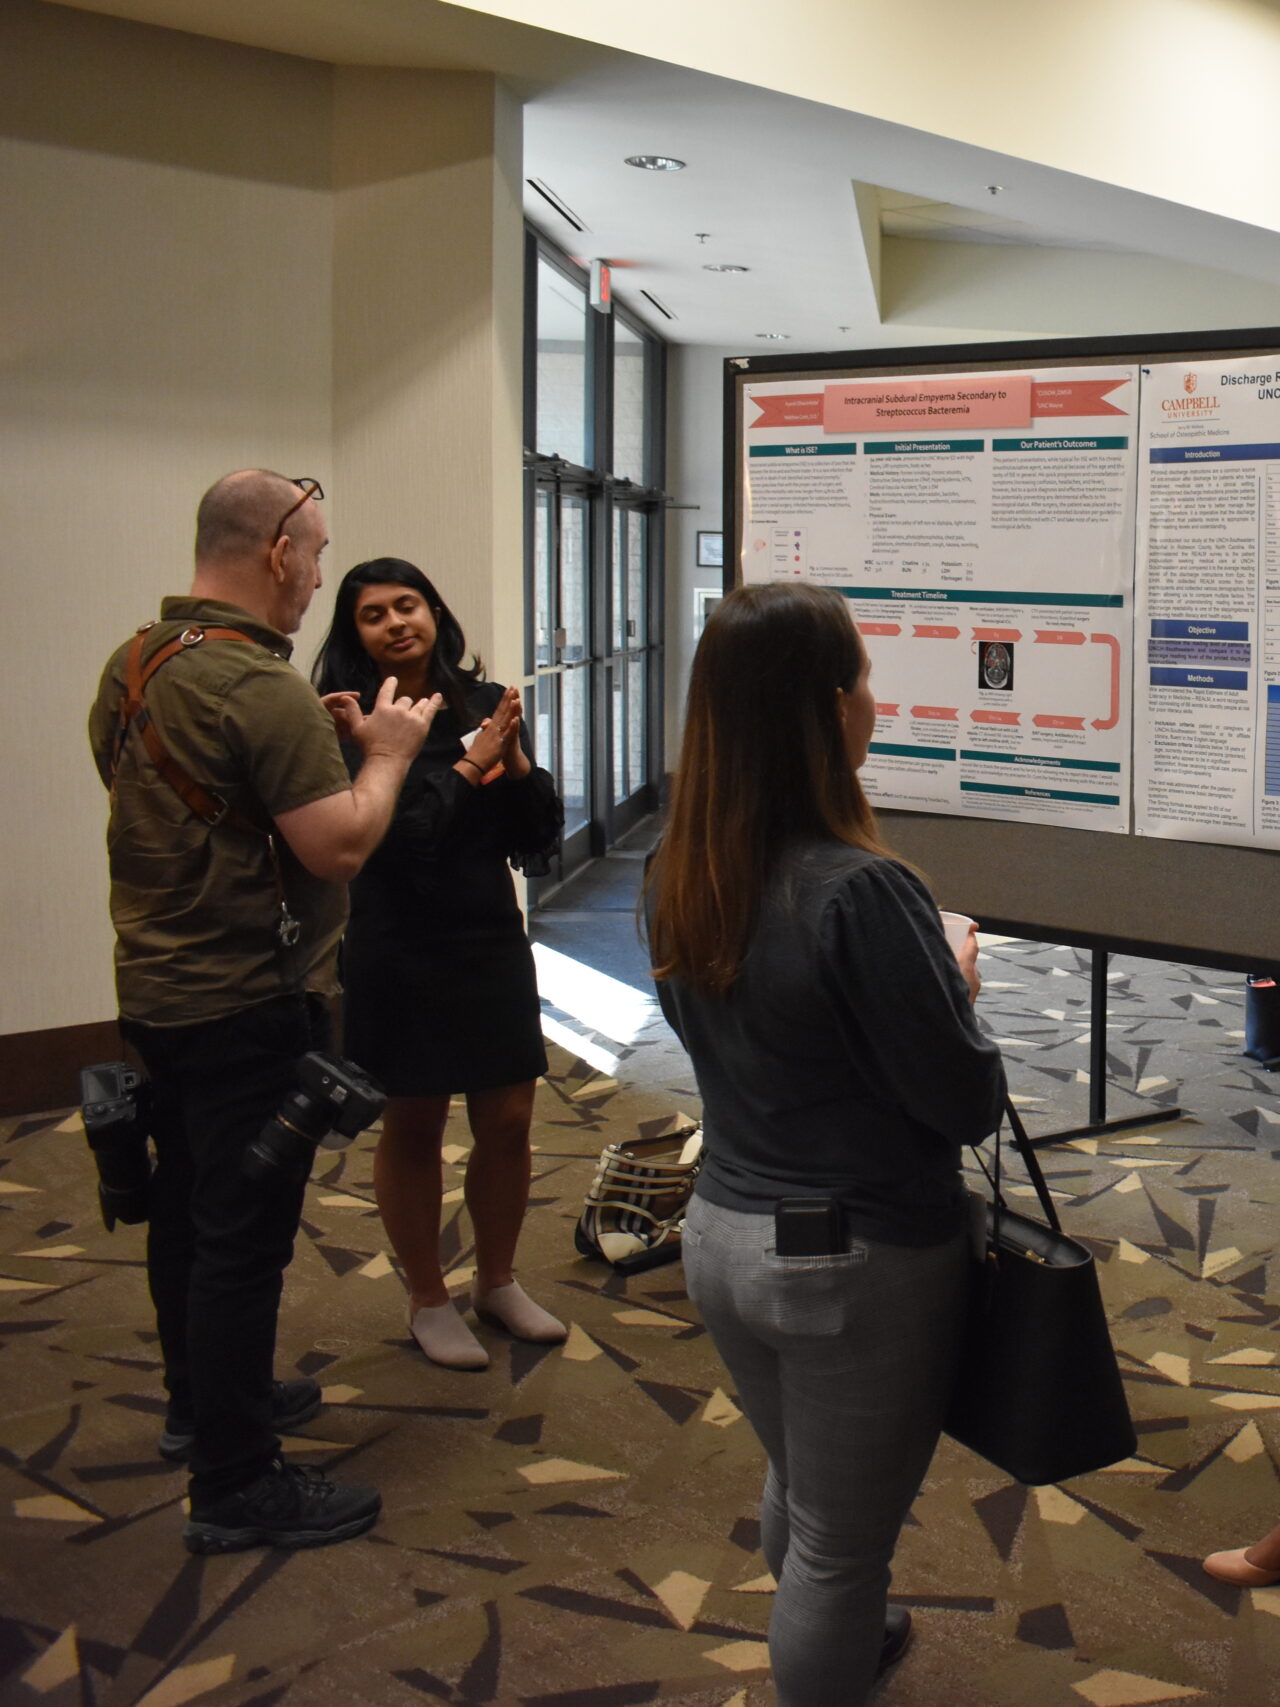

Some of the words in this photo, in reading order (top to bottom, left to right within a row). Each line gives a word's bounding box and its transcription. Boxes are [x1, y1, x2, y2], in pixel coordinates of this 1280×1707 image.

[1221, 372, 1271, 388] Discharge
[844, 396, 884, 404] Intracranial
[886, 394, 917, 403] Subdural
[919, 393, 955, 403] Empyema
[957, 391, 995, 402] Secondary
[1161, 396, 1221, 411] CAMPBELL
[876, 407, 926, 418] Streptococcus
[928, 406, 970, 414] Bacteremia
[1168, 410, 1213, 418] UNIVERSITY
[1185, 450, 1220, 458] Introduction
[891, 590, 921, 598] Treatment
[1188, 626, 1216, 635] Objective
